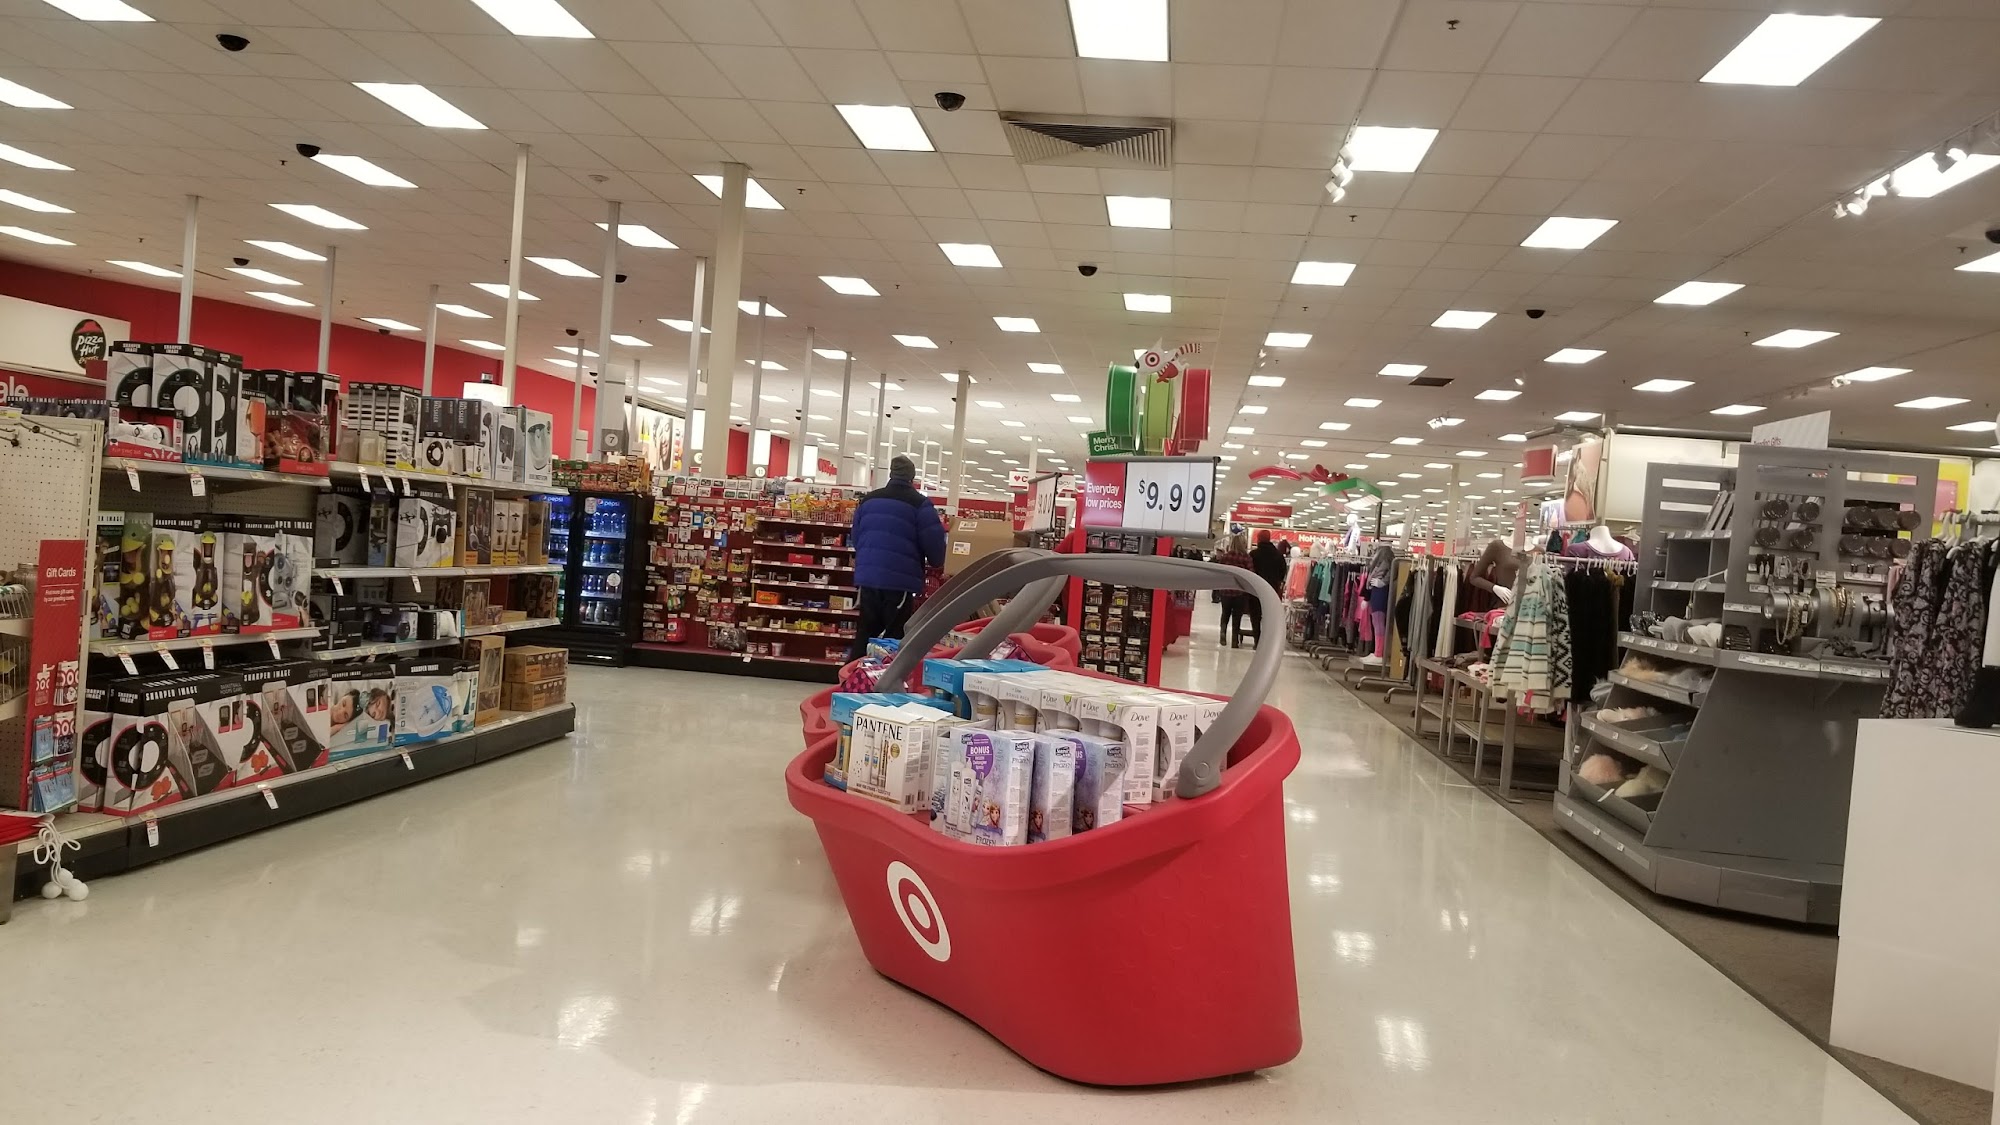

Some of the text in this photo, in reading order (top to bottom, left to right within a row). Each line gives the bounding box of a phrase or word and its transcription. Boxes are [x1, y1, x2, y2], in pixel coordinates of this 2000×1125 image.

[76, 335, 104, 351] Pizza
[80, 344, 100, 357] Hut
[1093, 436, 1116, 445] Merry
[1094, 443, 1119, 452] Christ
[1086, 482, 1120, 496] Everyday
[1086, 497, 1122, 510] low prices
[1248, 506, 1282, 514] School/Office
[275, 520, 312, 530] RPER IMAGE
[46, 567, 76, 578] Gift Cards
[428, 664, 439, 672] IMAGE
[244, 669, 291, 682] SHARPER IMAGE
[146, 686, 198, 701] SHARPER IMAGE
[1046, 693, 1058, 703] Dove
[1087, 702, 1100, 712] Dove
[1130, 712, 1150, 722] Dove
[1170, 712, 1188, 721] Dove
[1204, 709, 1220, 718] Dov
[856, 716, 903, 741] PANTENE
[970, 746, 990, 755] BONUS
[976, 835, 996, 846] FROZEN
